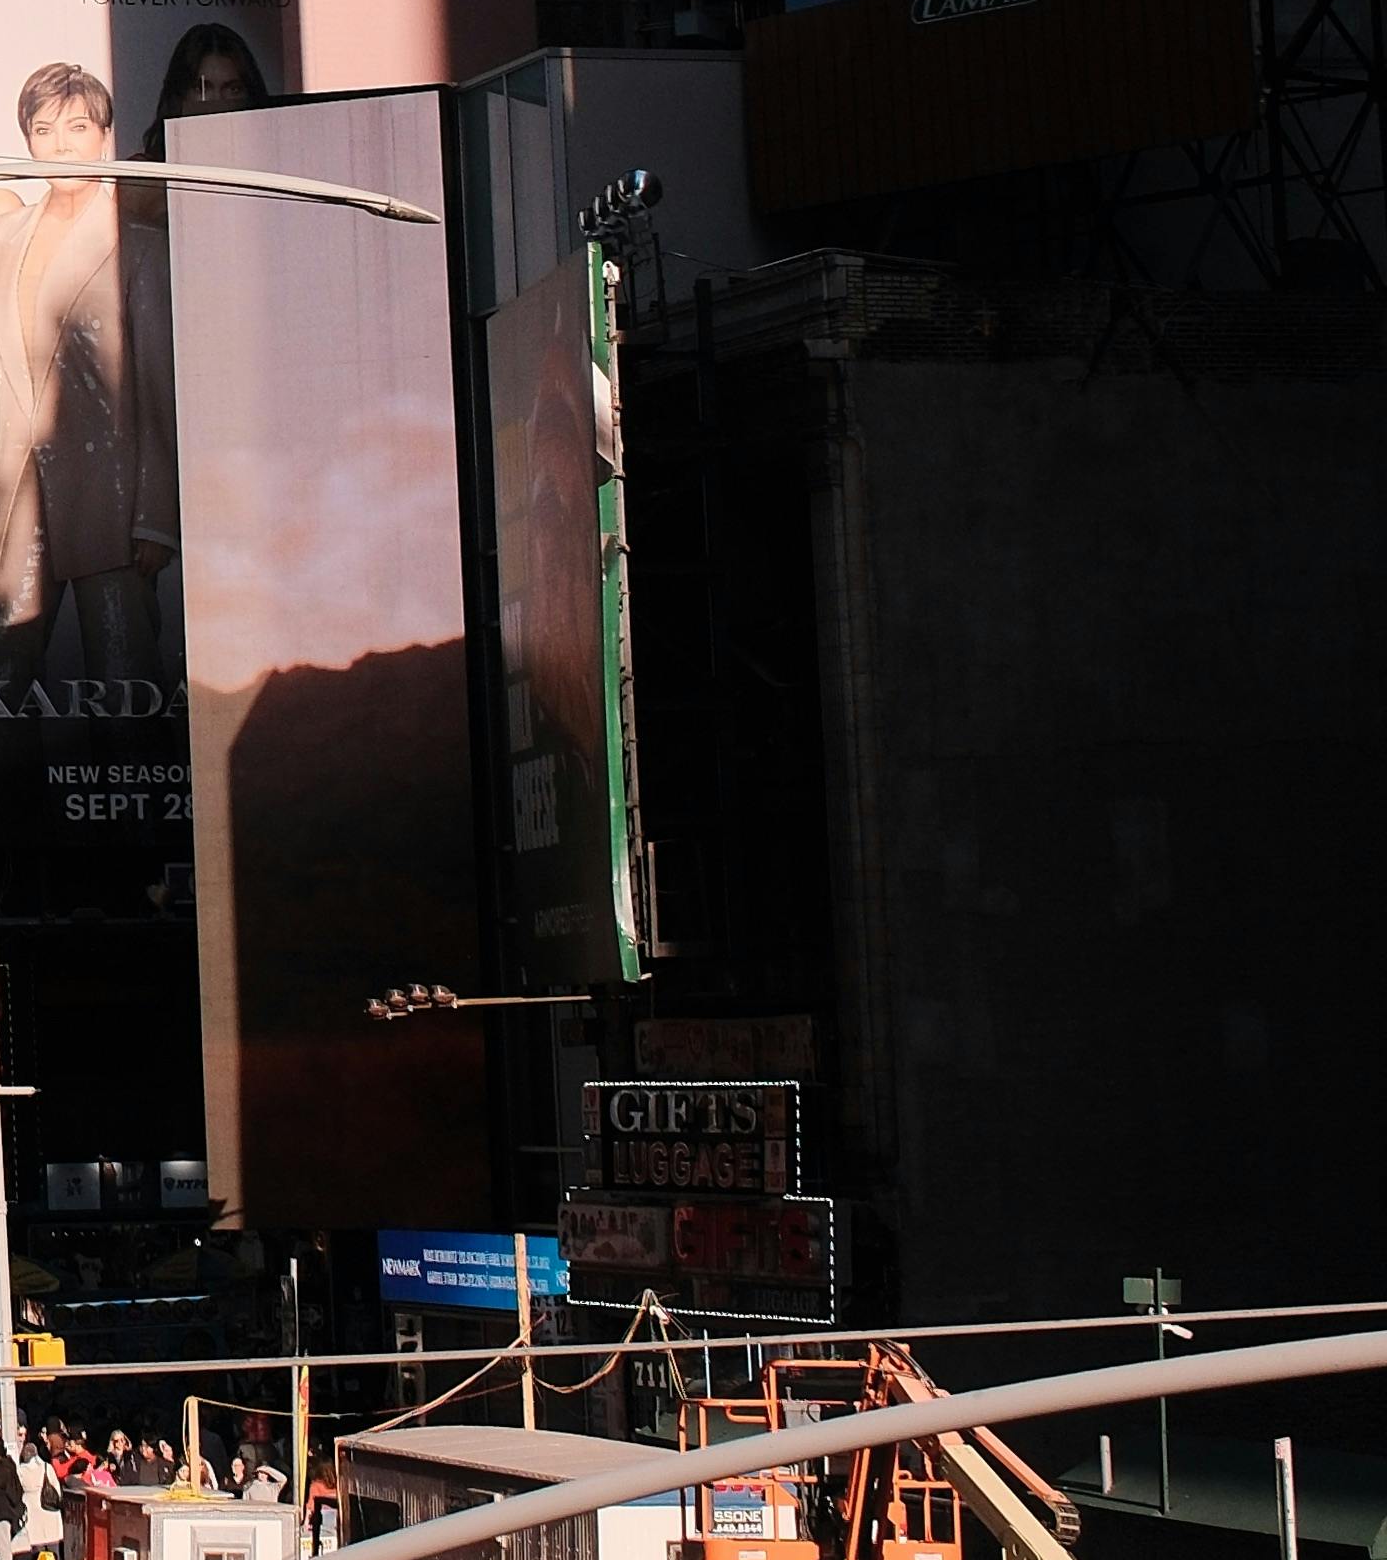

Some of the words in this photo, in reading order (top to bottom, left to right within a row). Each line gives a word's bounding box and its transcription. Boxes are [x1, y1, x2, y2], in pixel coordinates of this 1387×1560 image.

[48, 765, 99, 784] NEW
[107, 765, 191, 784] SEASO
[65, 793, 150, 821] SEPT
[610, 1089, 758, 1134] GIFTS
[612, 1140, 762, 1188] LUGGAGE
[634, 1361, 667, 1388] 711
